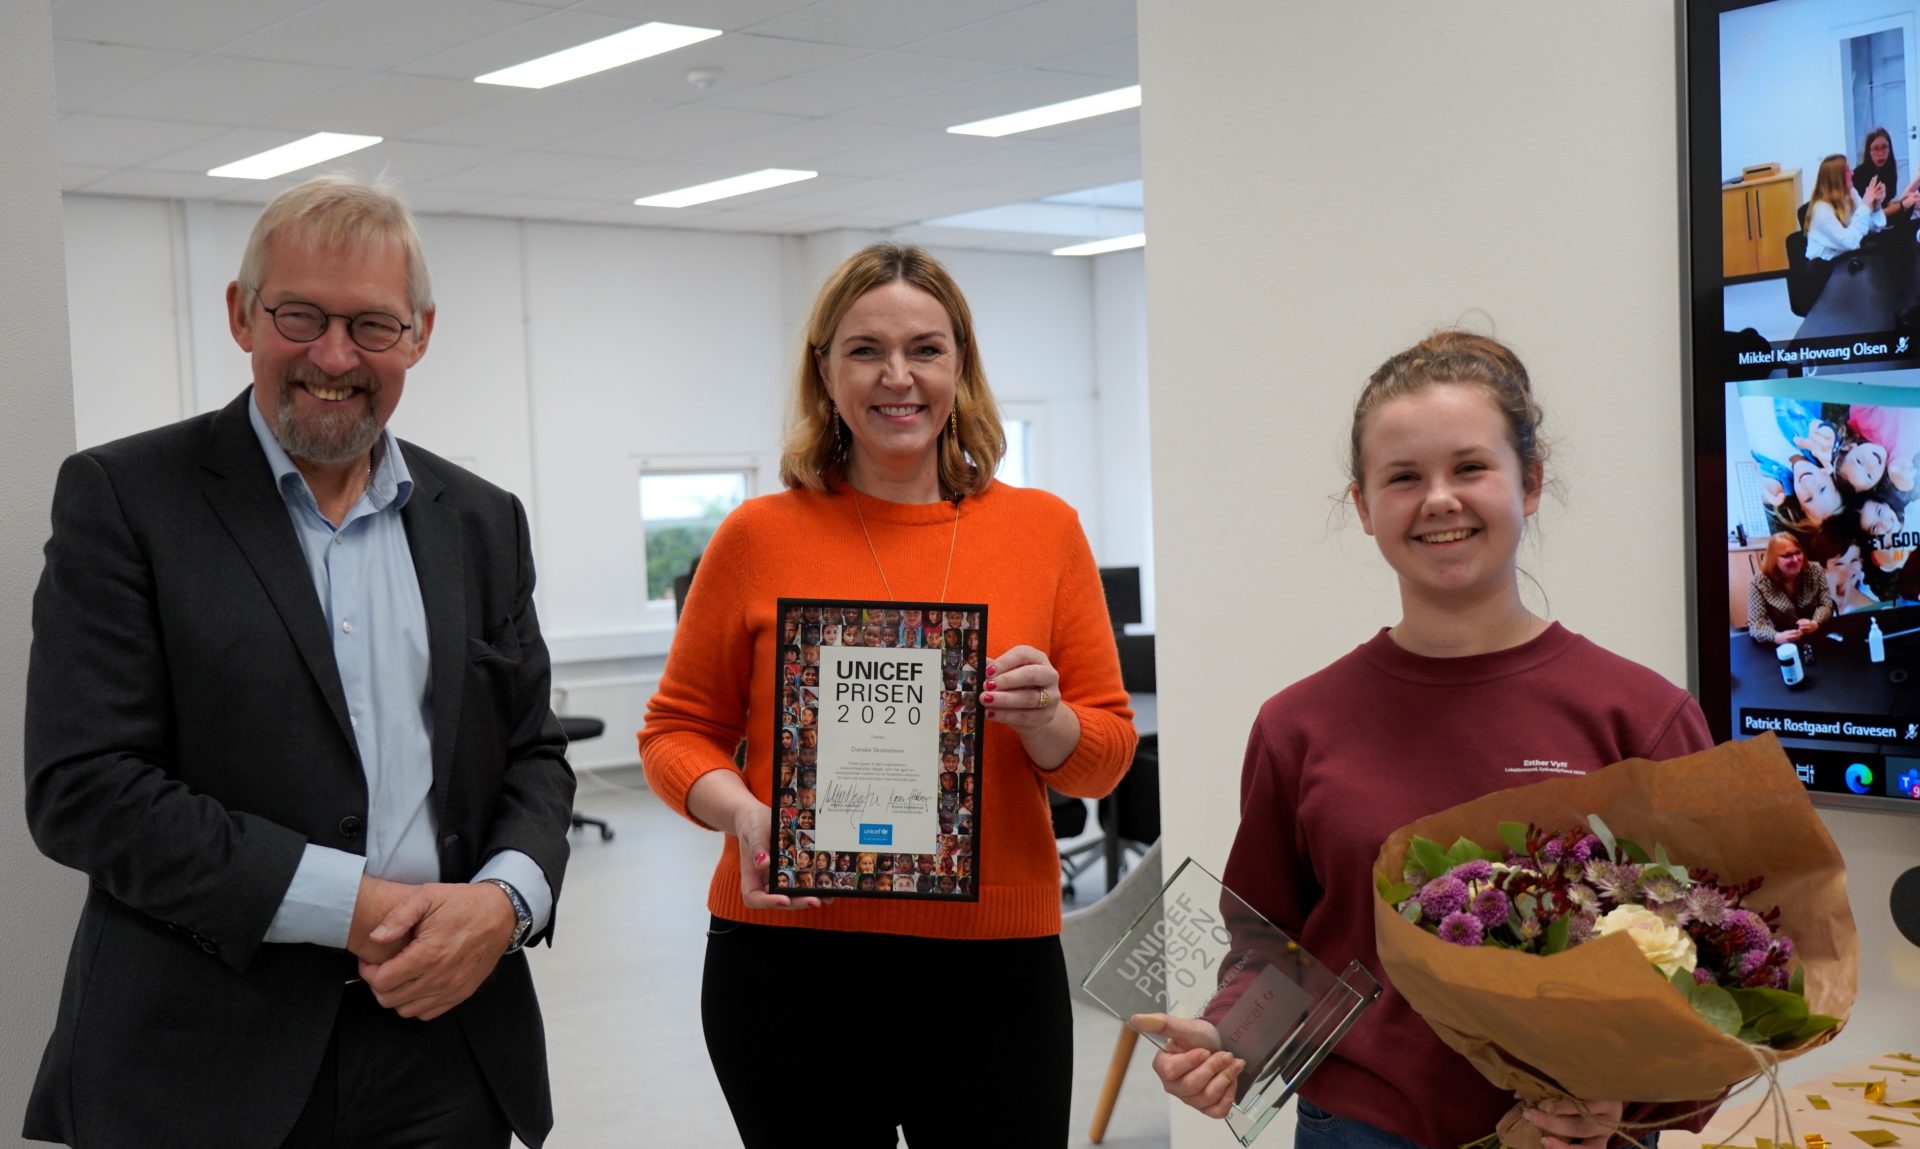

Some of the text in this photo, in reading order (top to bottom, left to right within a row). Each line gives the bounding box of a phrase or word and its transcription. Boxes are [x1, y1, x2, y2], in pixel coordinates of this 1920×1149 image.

[1738, 342, 1888, 365] Mikkel Kaa Hovvang Olsen
[836, 660, 924, 681] UNICEF
[836, 682, 923, 704] PRISEN
[1745, 715, 1897, 738] Patrick Rostgaard Gravesen
[1523, 759, 1549, 767] Esther
[1116, 892, 1192, 981] UNICEF
[1135, 908, 1216, 998] PRISEN
[1230, 999, 1265, 1043] unicef
